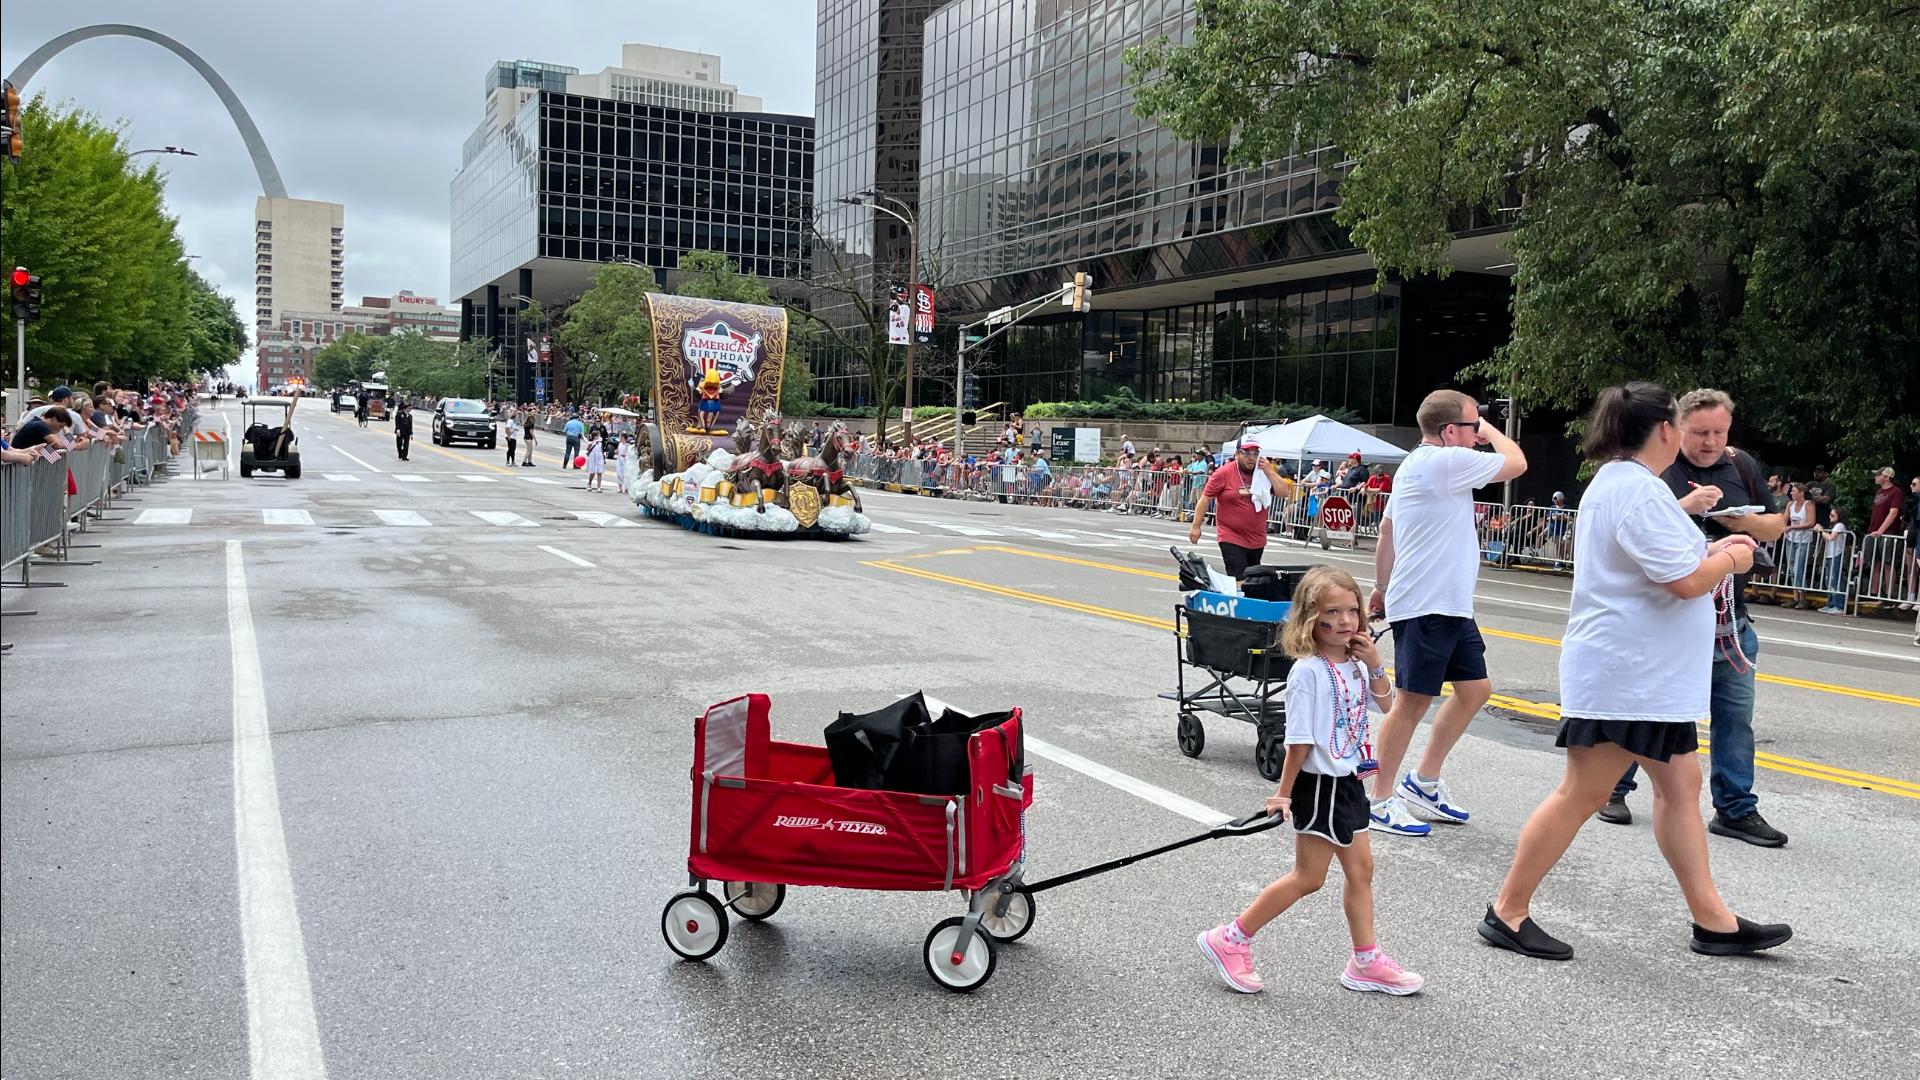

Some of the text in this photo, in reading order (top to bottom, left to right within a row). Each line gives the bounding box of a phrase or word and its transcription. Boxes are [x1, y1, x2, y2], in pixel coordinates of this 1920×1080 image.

[690, 349, 751, 363] BIRTHDAY
[1324, 508, 1352, 523] STOP
[1199, 598, 1238, 618] her
[773, 815, 887, 835] RADIO FLYER
